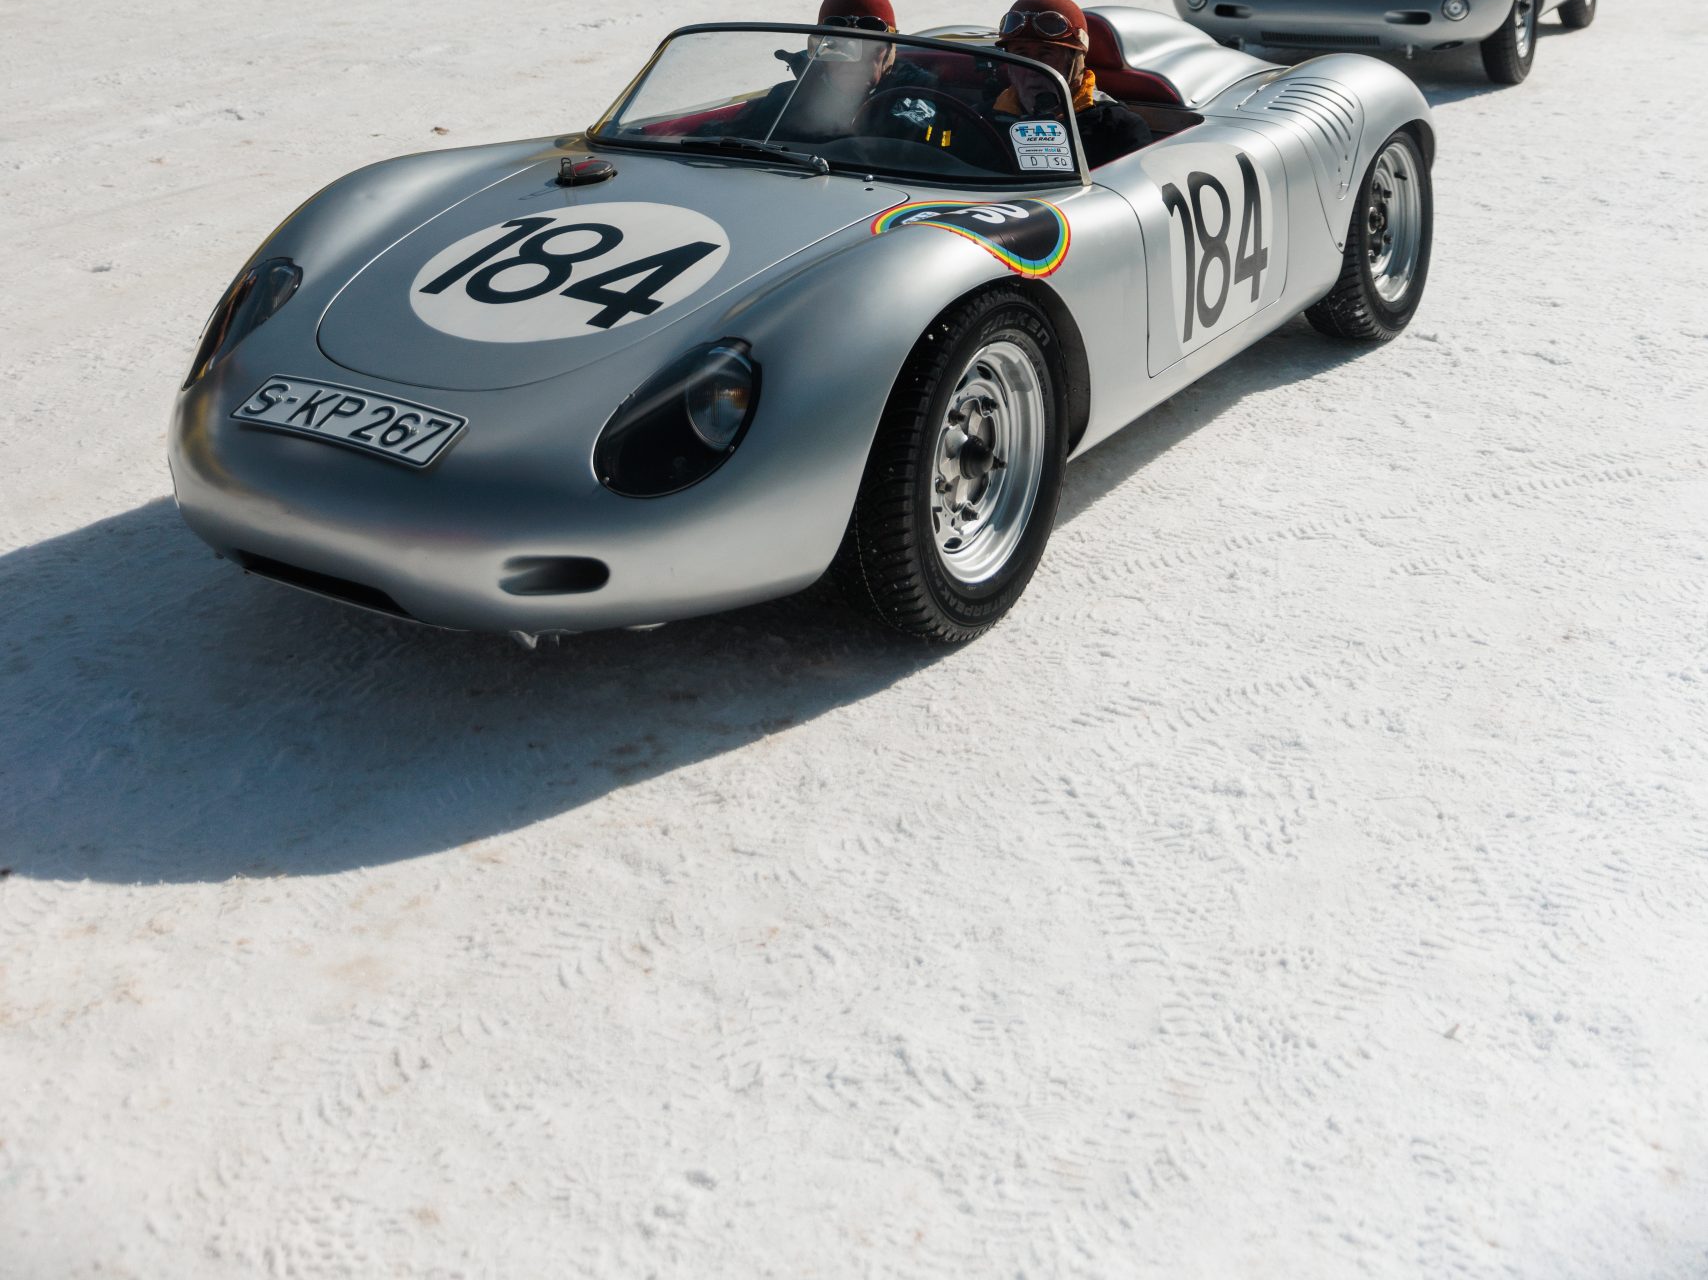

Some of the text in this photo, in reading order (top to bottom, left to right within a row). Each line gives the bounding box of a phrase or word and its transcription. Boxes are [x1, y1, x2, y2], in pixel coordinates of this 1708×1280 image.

[419, 216, 722, 329] 184
[1161, 152, 1268, 344] 184
[349, 405, 454, 454] 267
